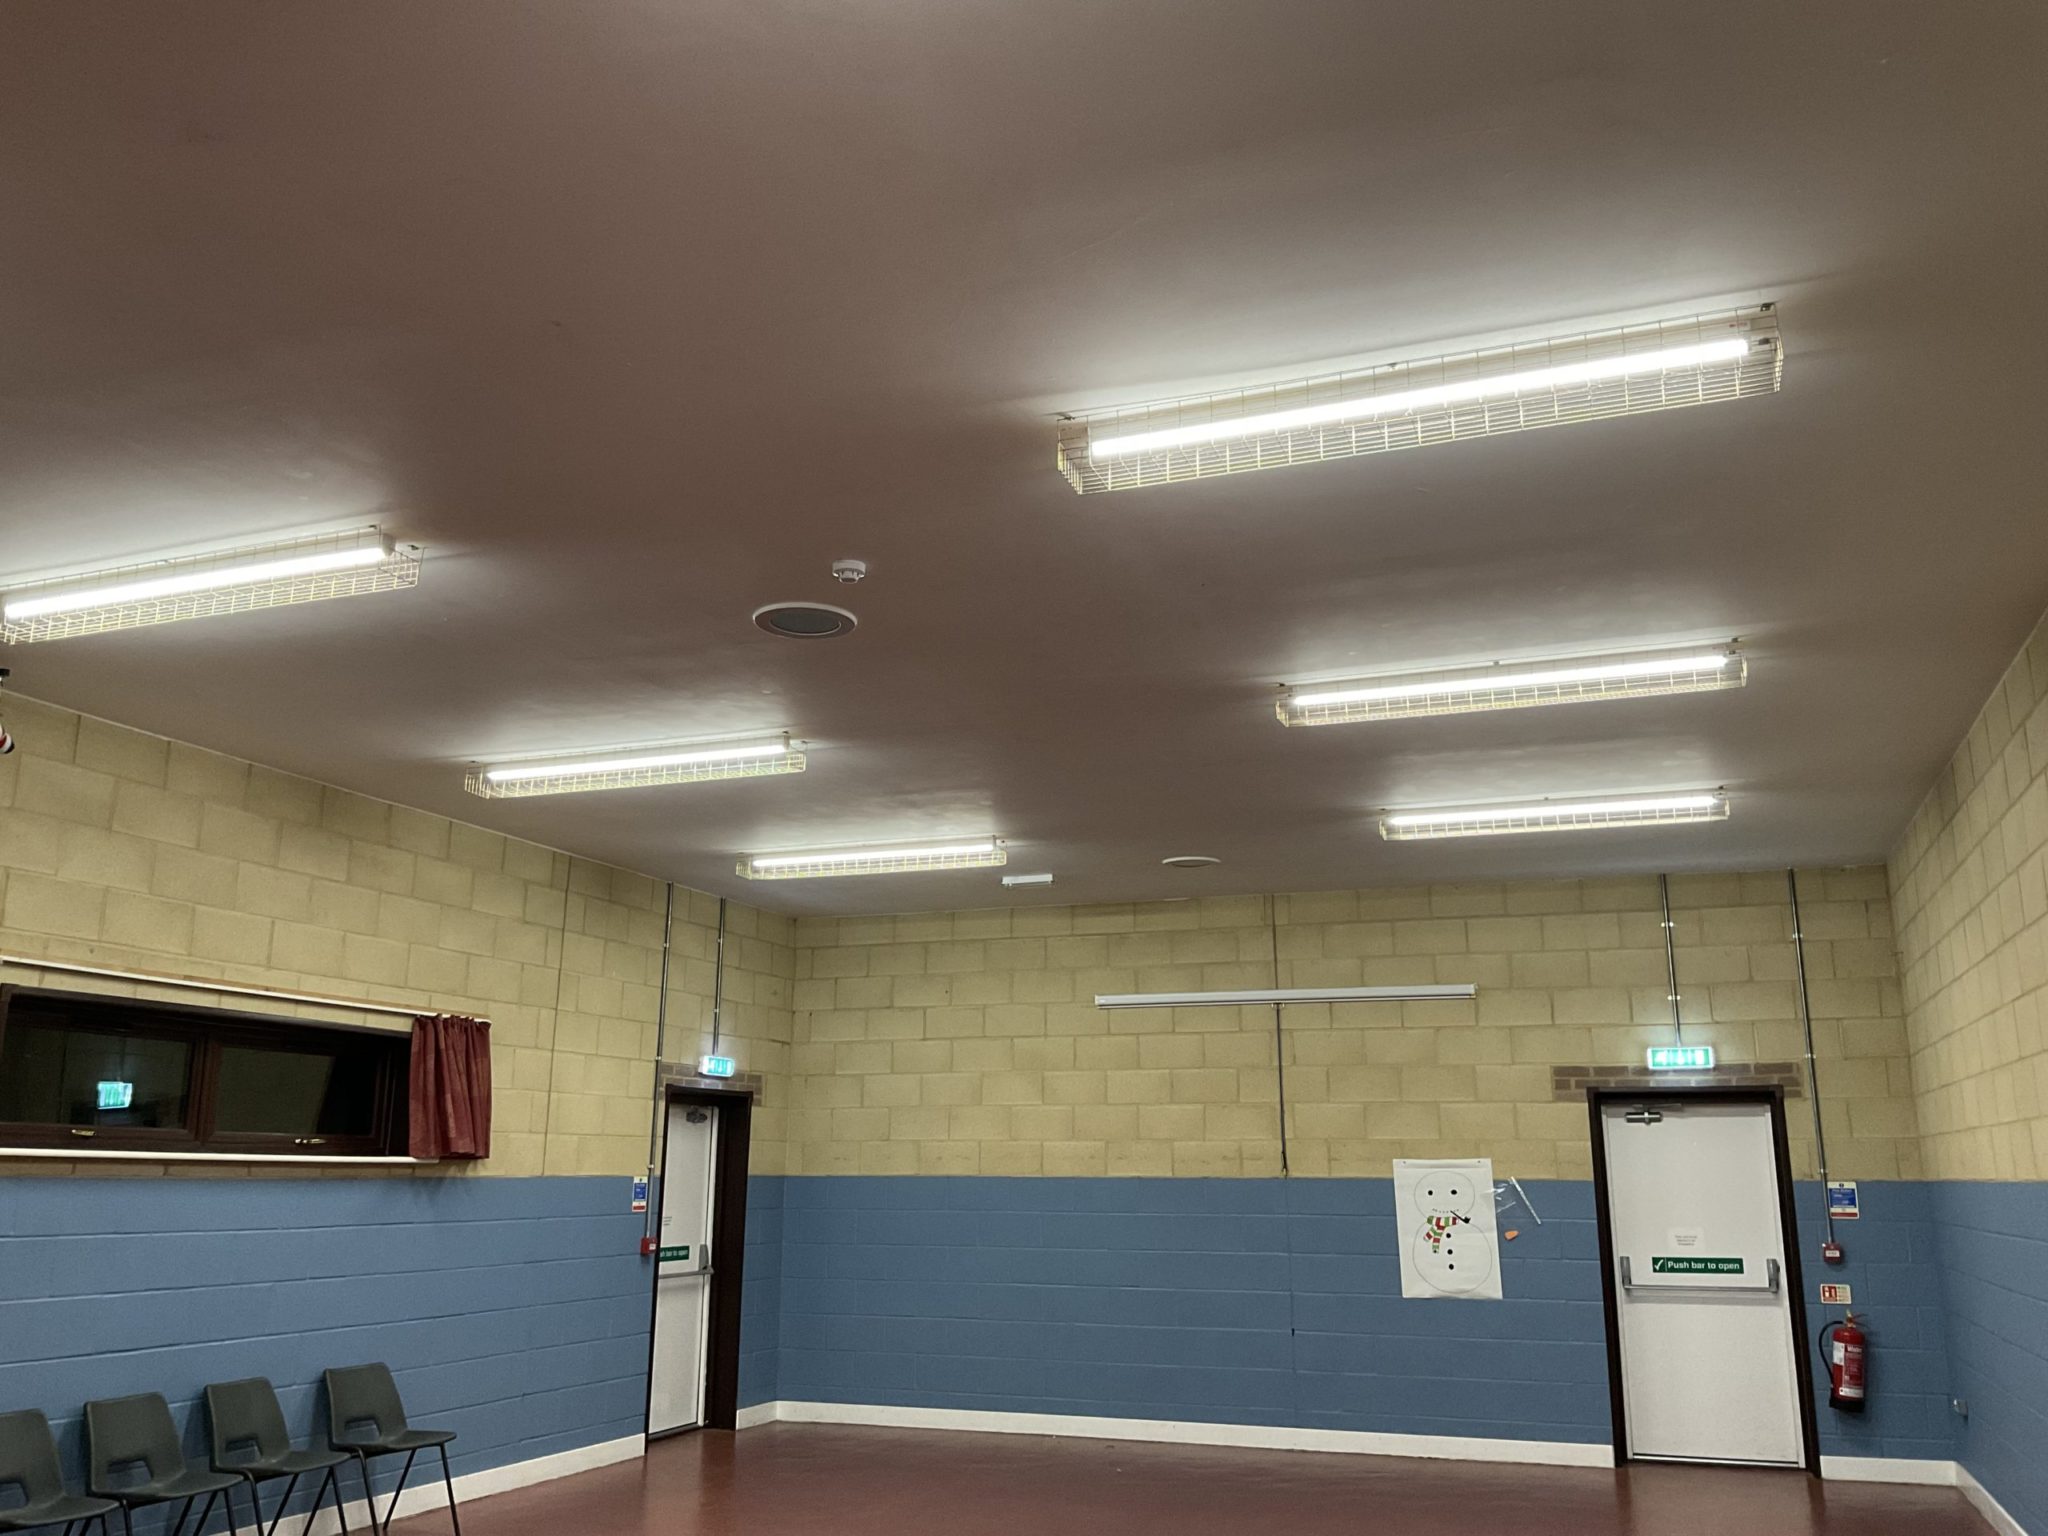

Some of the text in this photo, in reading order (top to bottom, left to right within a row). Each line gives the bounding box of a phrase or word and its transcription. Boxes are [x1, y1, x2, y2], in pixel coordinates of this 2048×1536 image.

[1667, 1261, 1689, 1269] Push
[1691, 1261, 1705, 1269] bar
[1718, 1263, 1739, 1271] open
